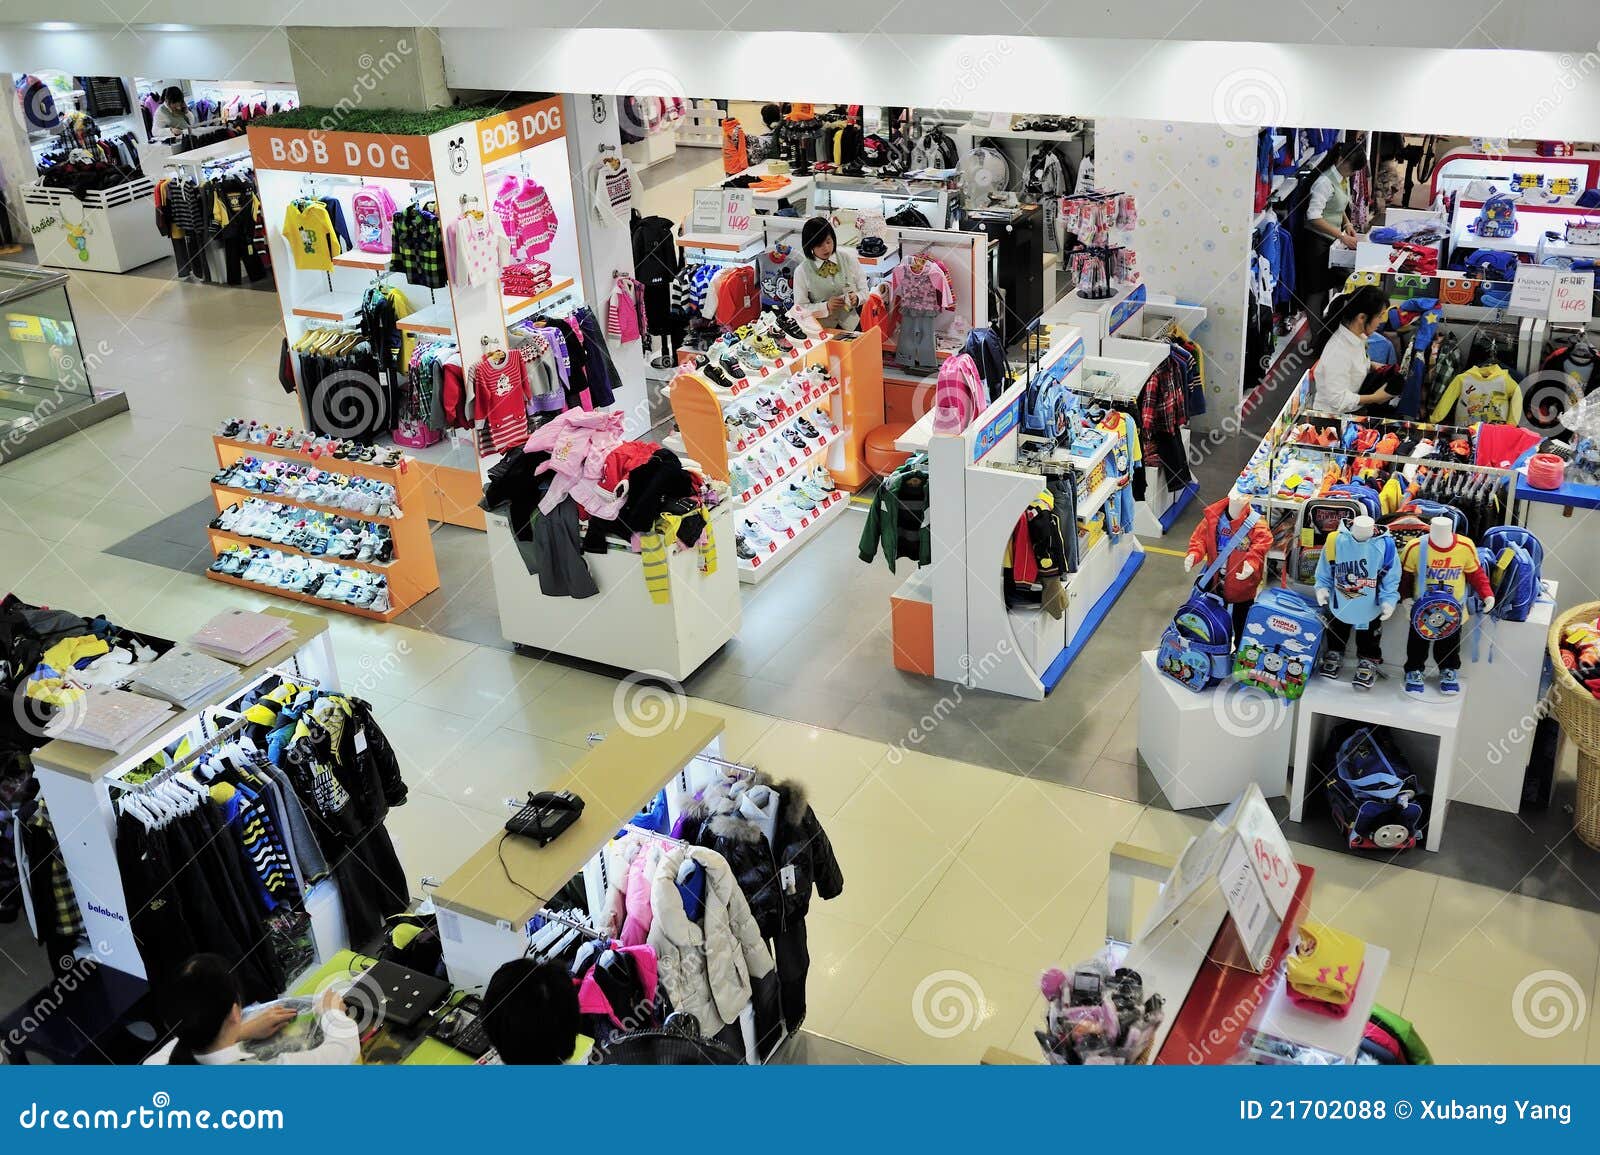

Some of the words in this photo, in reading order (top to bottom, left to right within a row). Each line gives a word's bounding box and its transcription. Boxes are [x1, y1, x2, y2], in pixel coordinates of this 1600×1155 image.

[481, 121, 519, 155] BOB
[522, 106, 562, 139] DOG
[269, 136, 330, 165] BOB
[344, 141, 411, 171] DOG
[87, 901, 125, 922] balabala
